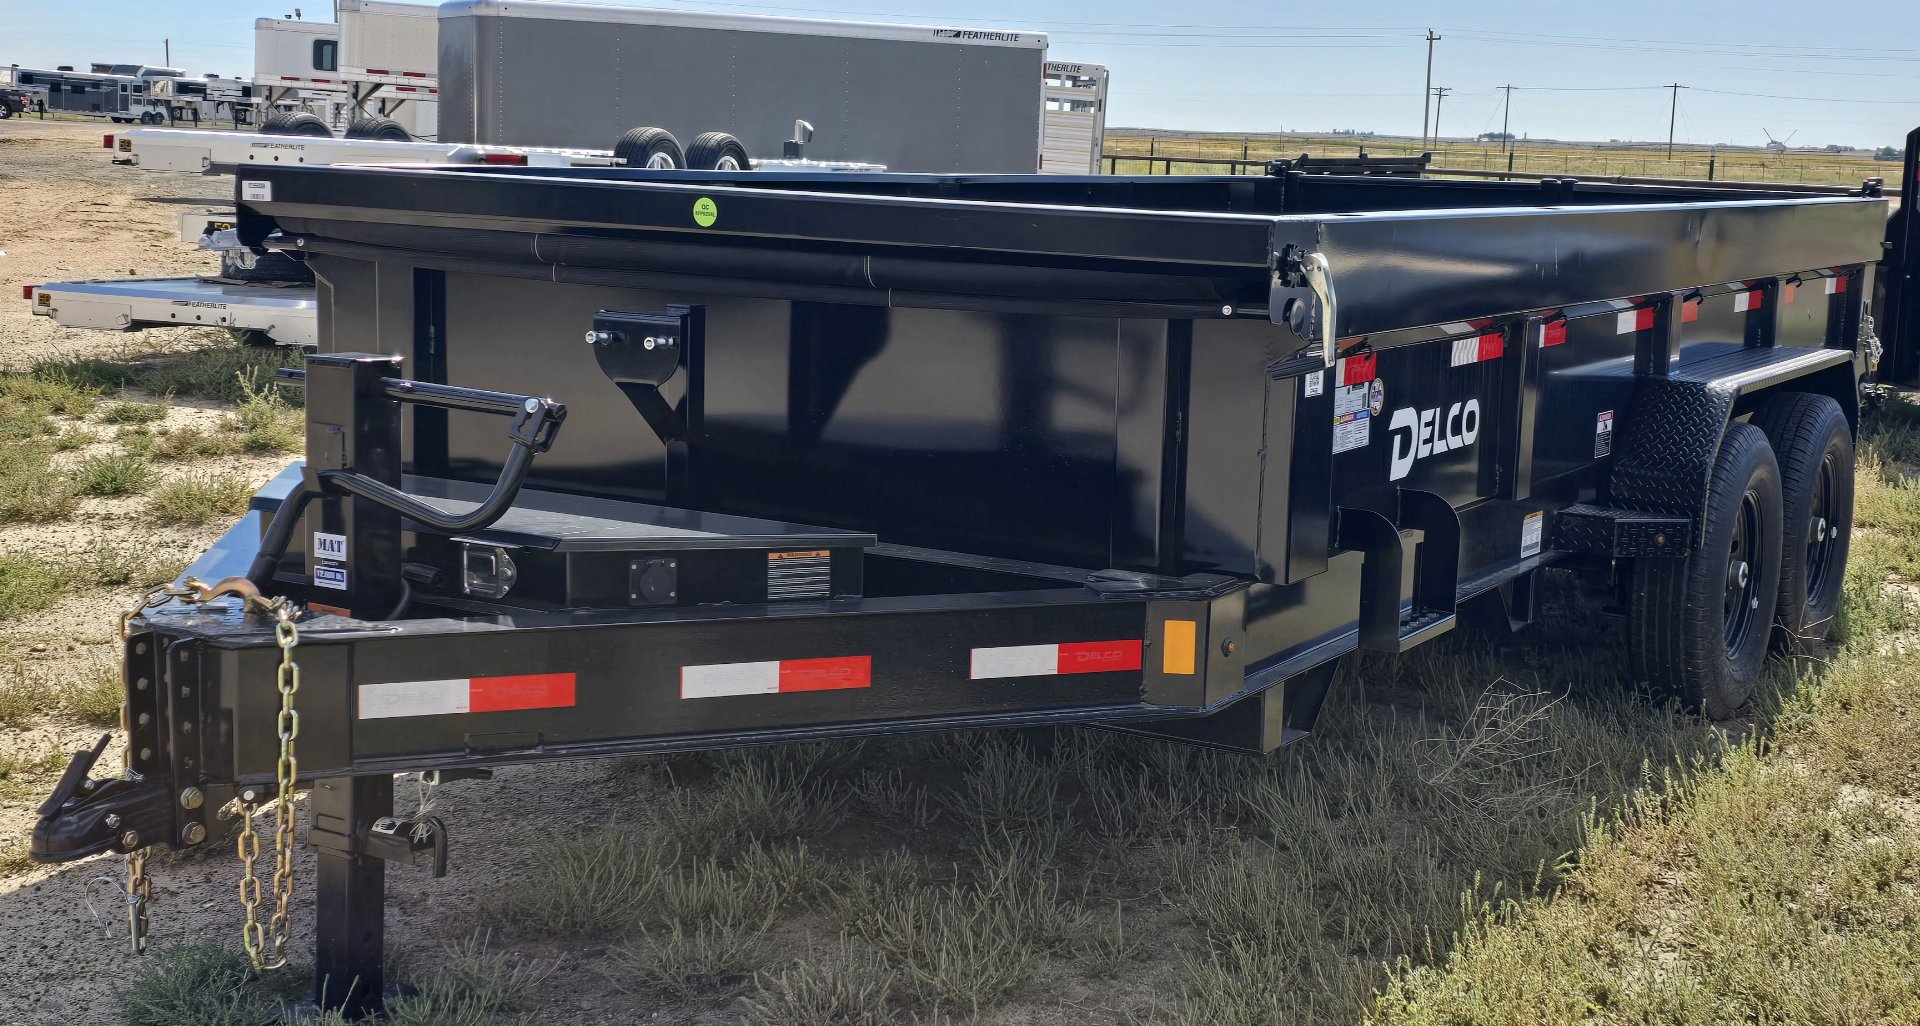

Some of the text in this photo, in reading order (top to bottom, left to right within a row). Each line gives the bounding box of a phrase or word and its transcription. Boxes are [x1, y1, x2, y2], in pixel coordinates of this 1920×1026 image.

[962, 30, 1020, 42] FEATHERLITE
[267, 143, 305, 151] FEATHERLITE
[189, 301, 227, 310] FEATHERLITE
[1388, 398, 1480, 482] DELCO
[317, 538, 343, 553] MAT
